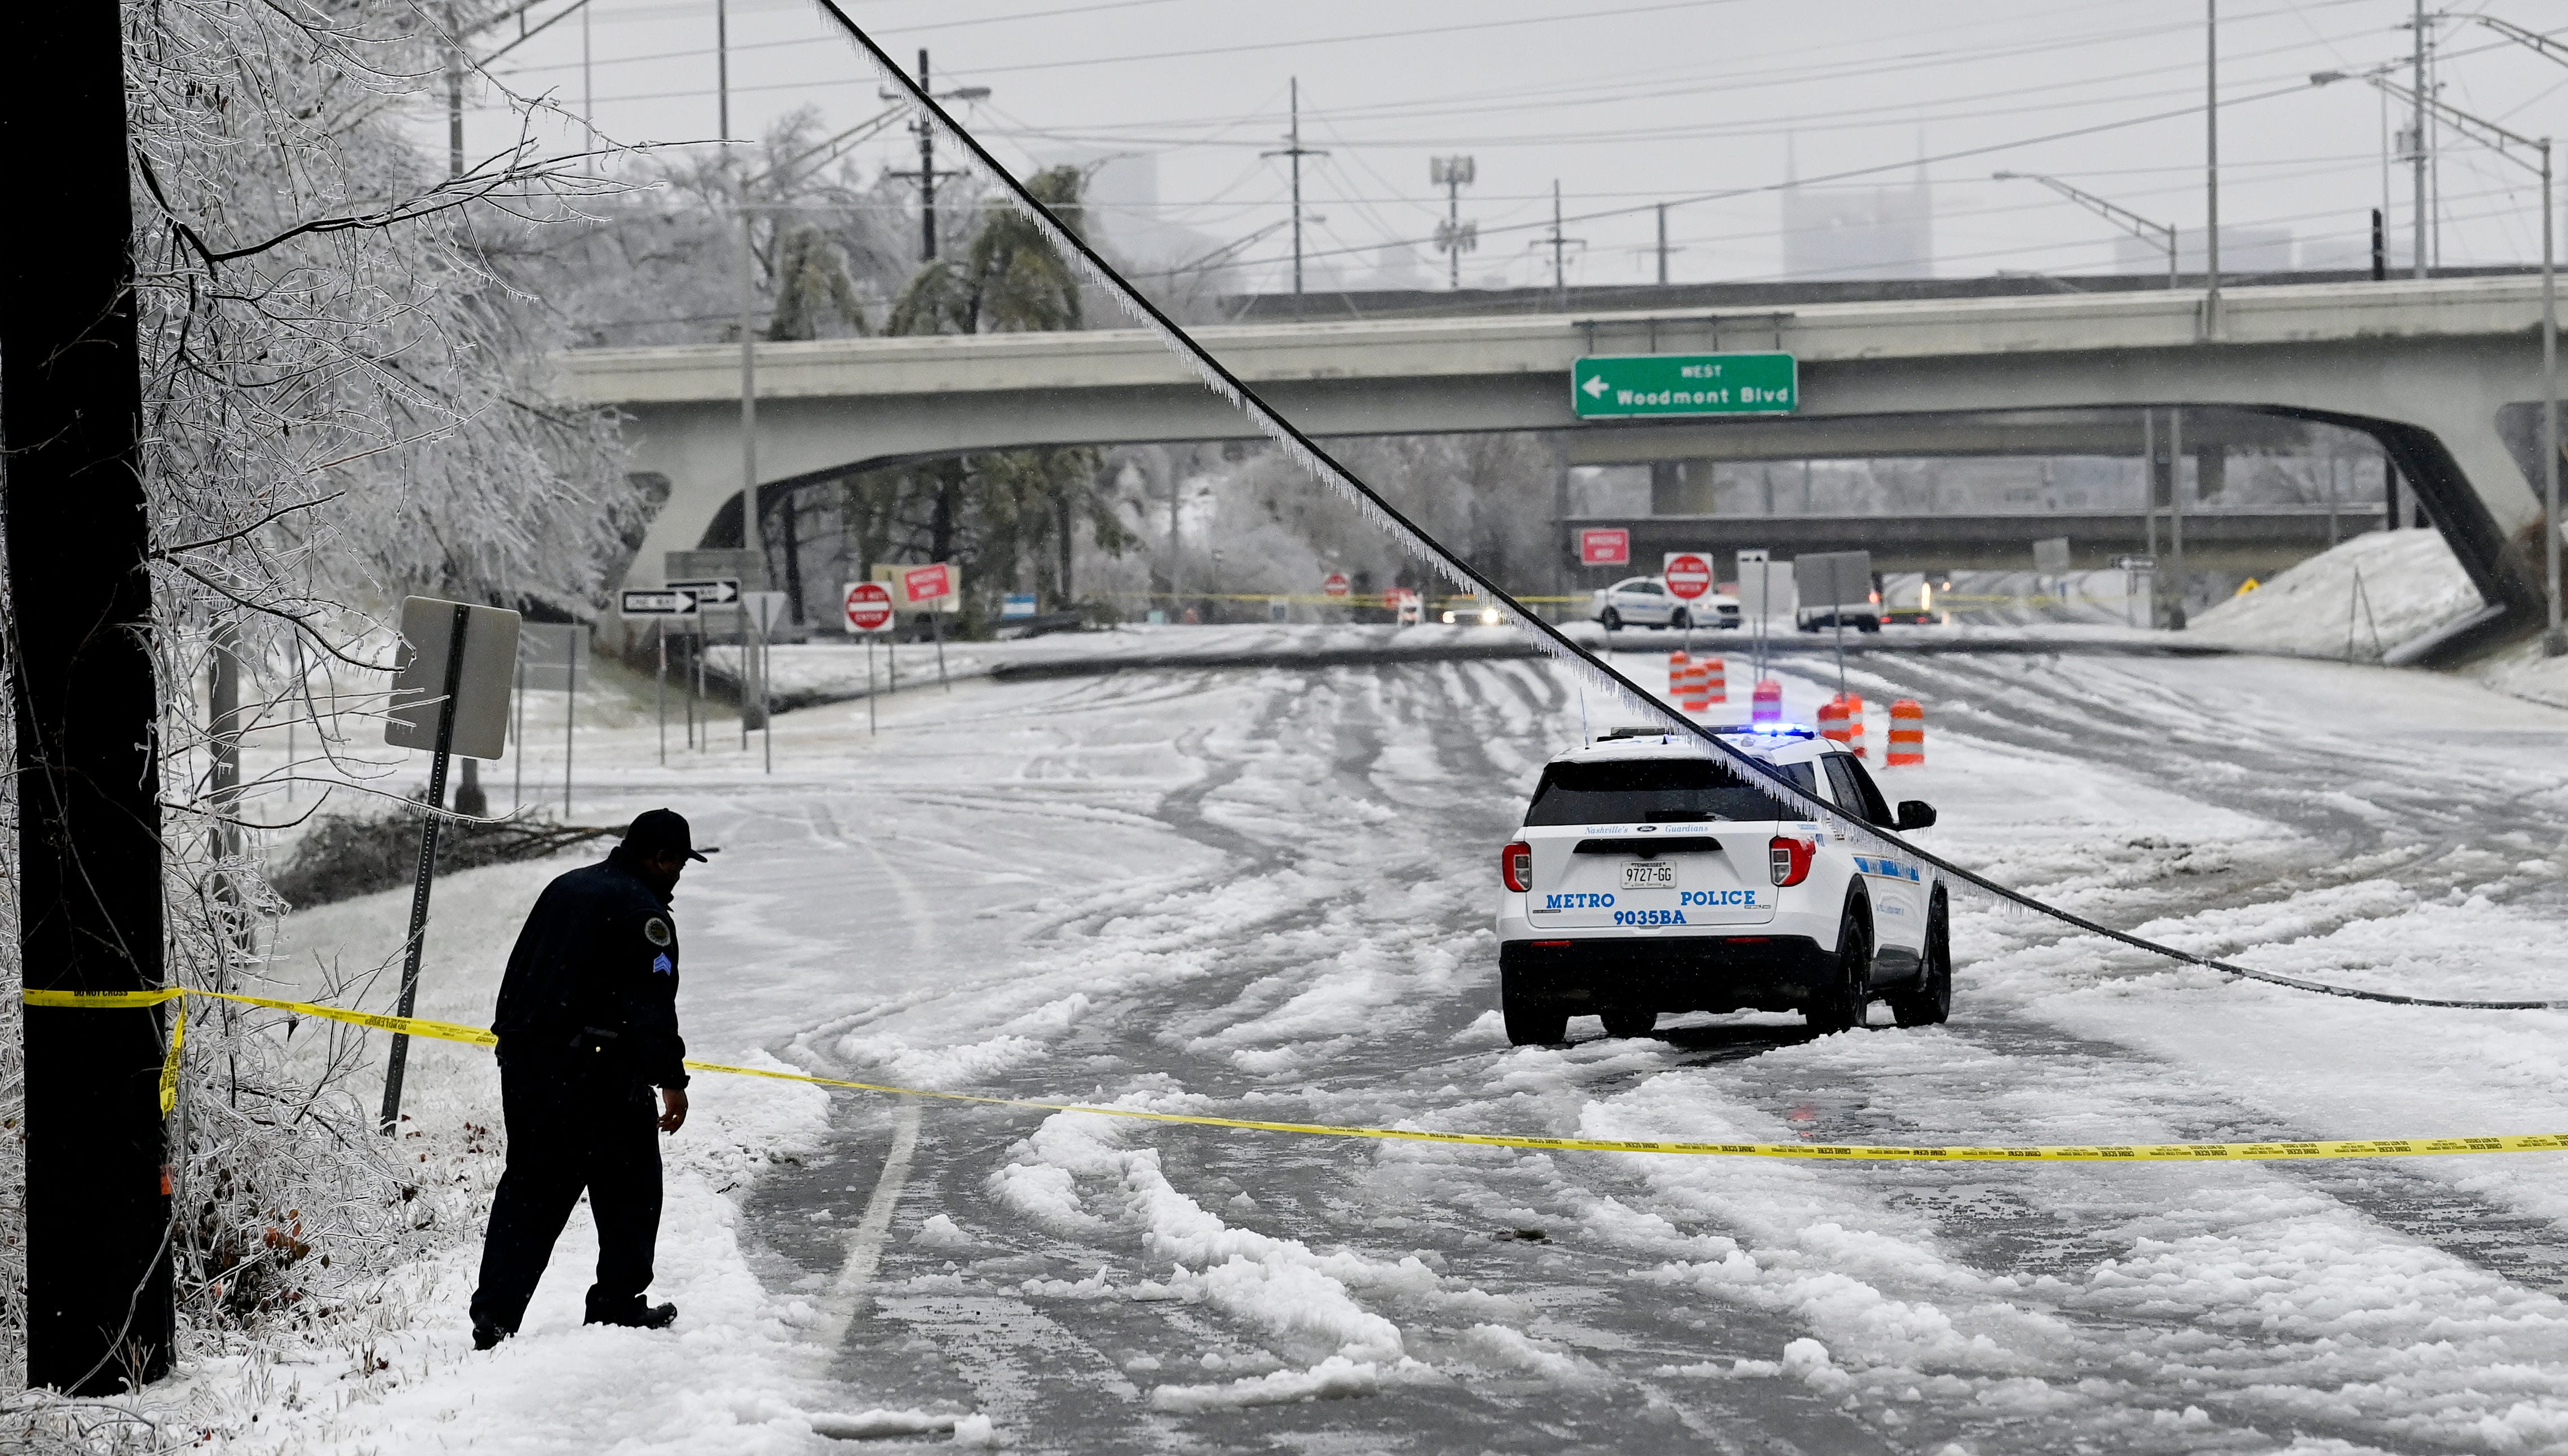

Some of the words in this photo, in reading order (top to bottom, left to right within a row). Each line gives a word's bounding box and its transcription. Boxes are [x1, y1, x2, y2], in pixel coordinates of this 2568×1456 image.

[1682, 364, 1722, 378] WEST
[1617, 388, 1729, 405] Woodmont
[1740, 387, 1788, 403] Blvd
[1585, 826, 1628, 834] Nashville's
[1626, 868, 1671, 882] 9727-GG
[1546, 893, 1615, 909] METRO
[1681, 891, 1755, 906] POLICE
[1614, 910, 1686, 925] 9035BA
